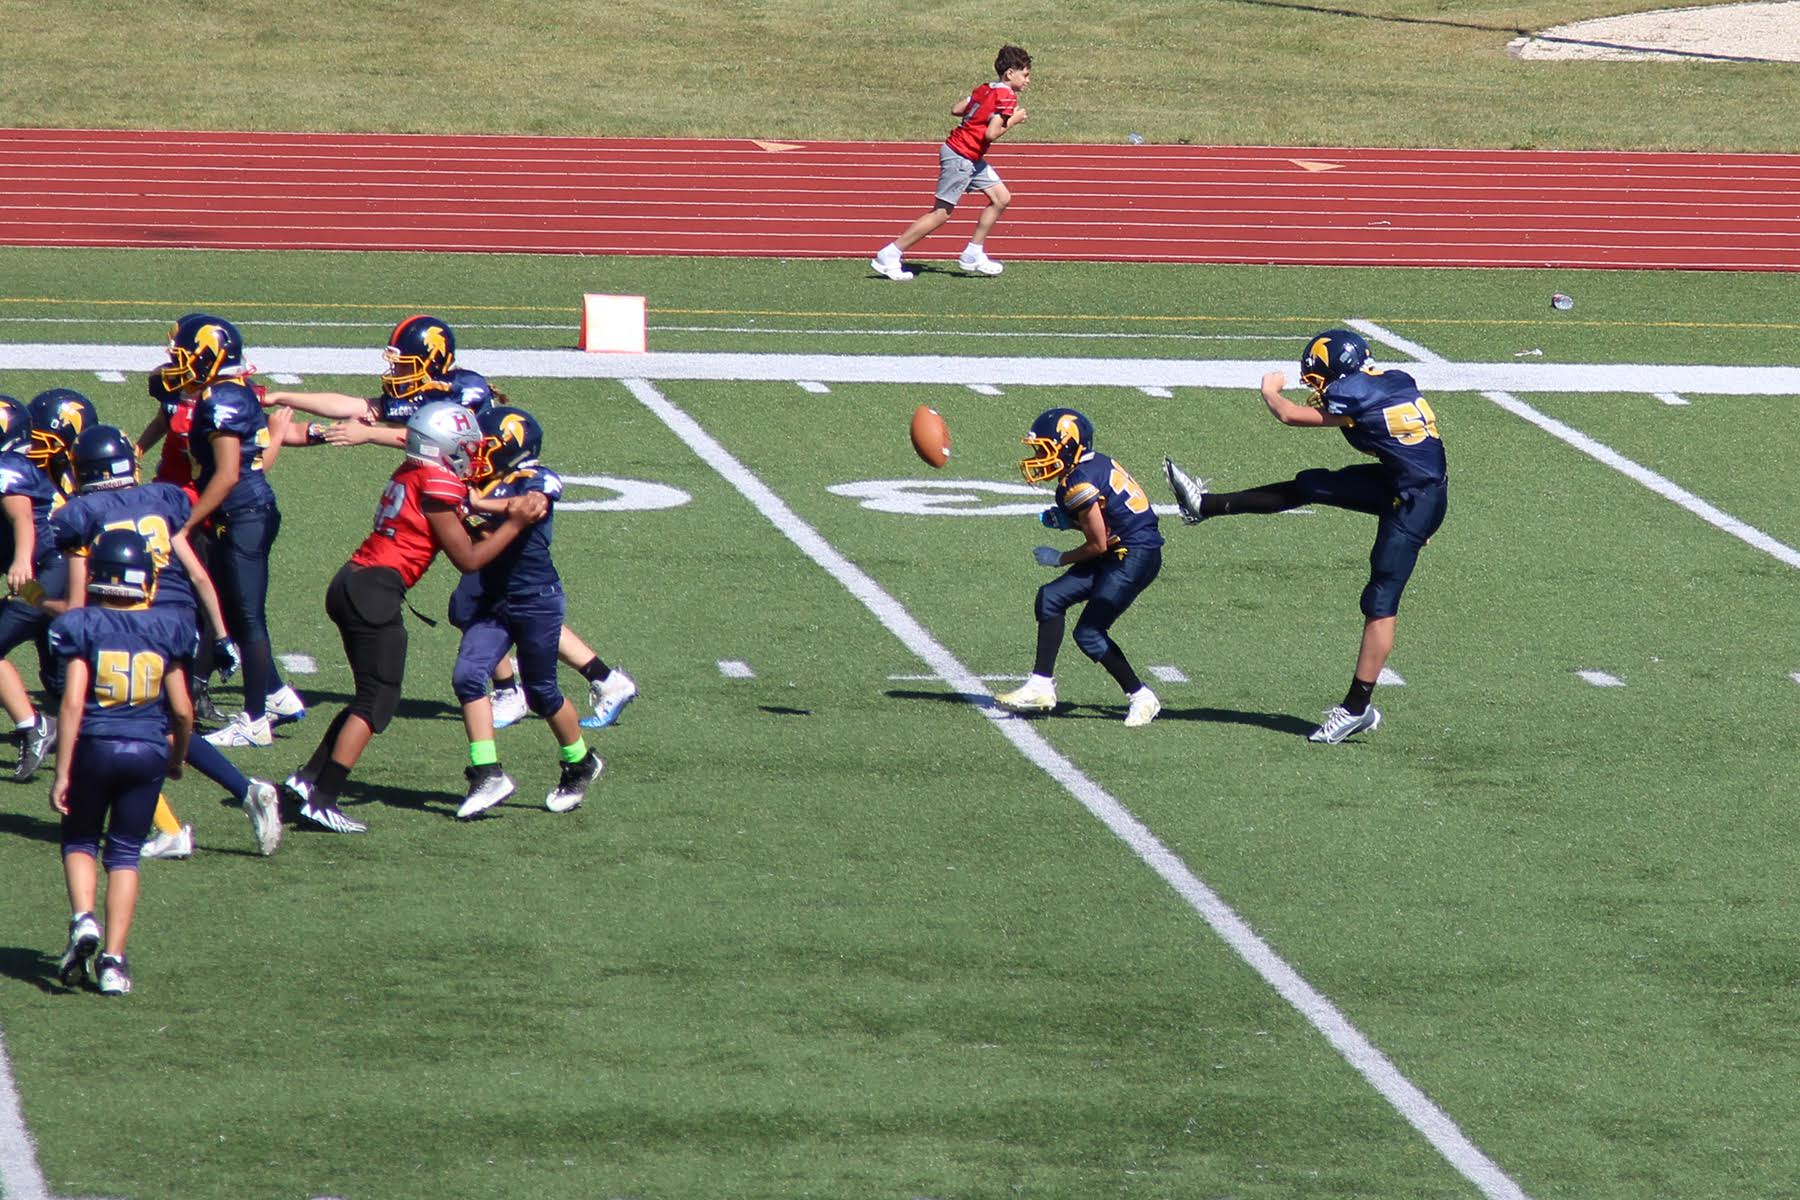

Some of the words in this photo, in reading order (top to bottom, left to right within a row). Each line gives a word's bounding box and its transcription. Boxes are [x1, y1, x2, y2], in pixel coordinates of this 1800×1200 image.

[454, 413, 472, 432] H
[1109, 459, 1149, 514] 3
[104, 515, 171, 568] 3
[96, 650, 165, 708] 50
